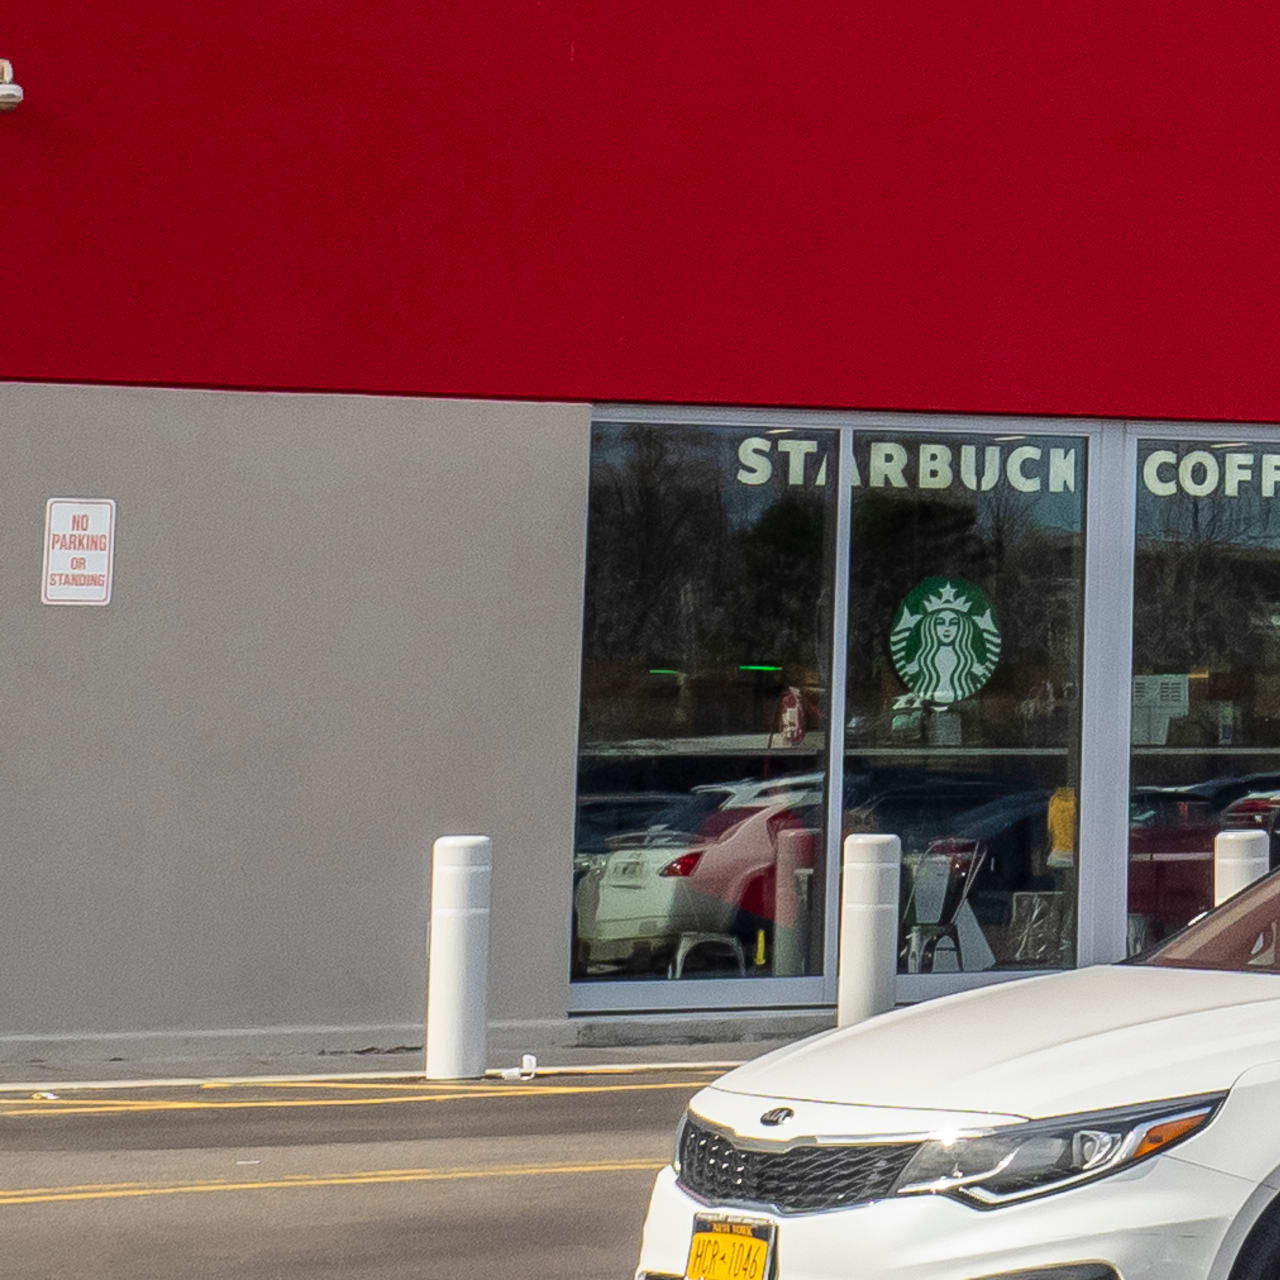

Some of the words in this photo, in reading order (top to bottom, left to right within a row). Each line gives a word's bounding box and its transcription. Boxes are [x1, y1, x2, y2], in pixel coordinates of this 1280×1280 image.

[71, 514, 89, 531] NO
[51, 533, 107, 551] PARKING
[70, 557, 86, 570] OR
[49, 573, 105, 587] STANDING
